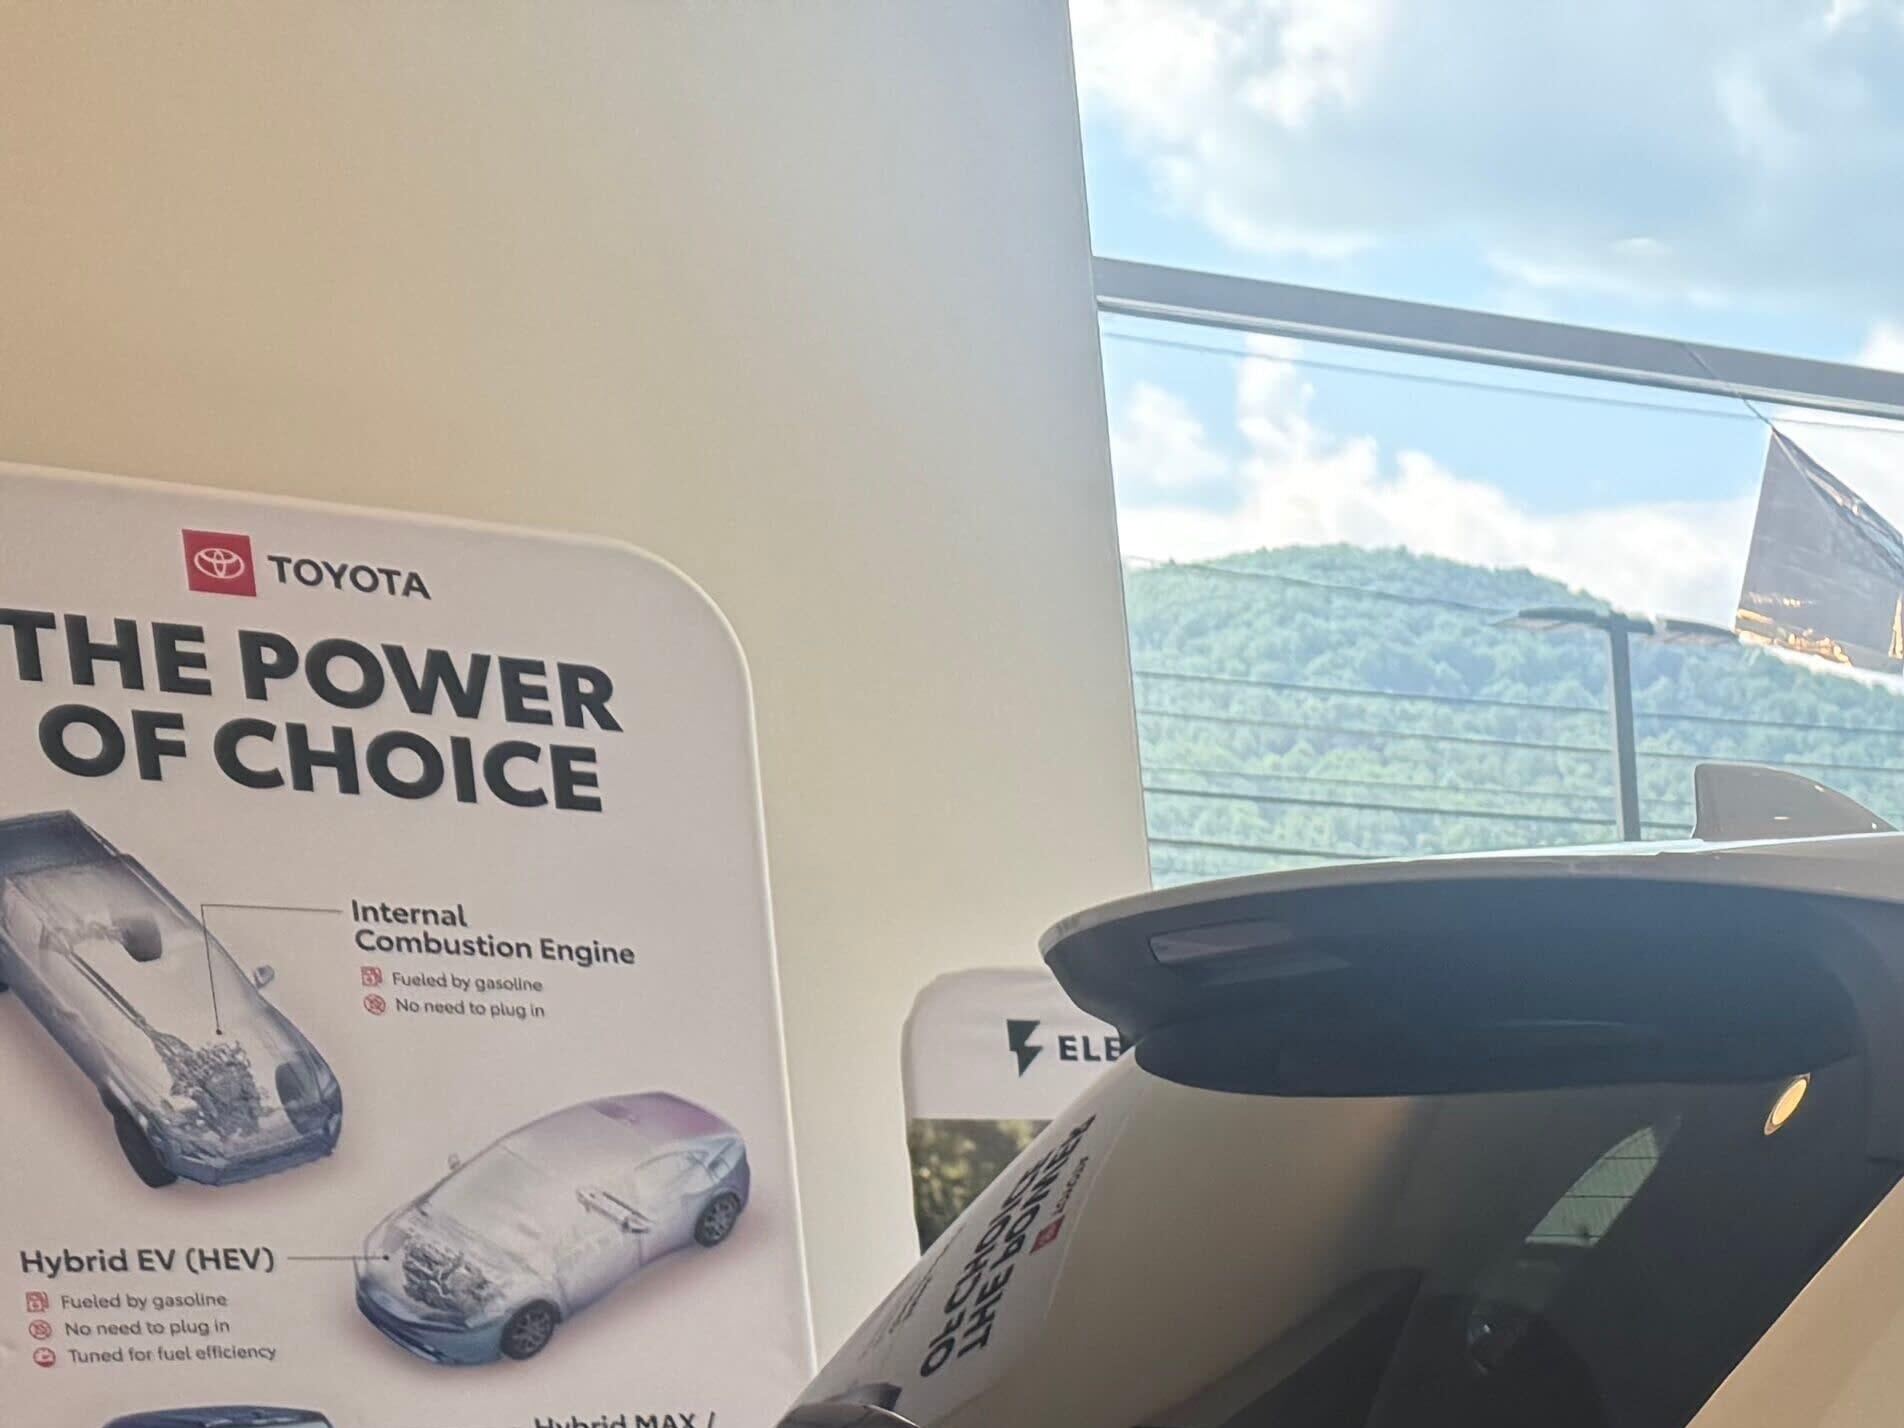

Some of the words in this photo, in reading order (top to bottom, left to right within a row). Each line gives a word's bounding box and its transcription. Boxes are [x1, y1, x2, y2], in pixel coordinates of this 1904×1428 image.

[267, 554, 431, 600] TOYOTA
[0, 607, 213, 696] THE
[237, 629, 623, 732] POWER
[39, 704, 187, 781] OF
[214, 718, 603, 812] CHOICE
[352, 899, 468, 928] Internal
[355, 929, 532, 959] Combustion
[540, 938, 636, 967] Engine
[392, 972, 447, 988] Fueled
[451, 974, 470, 991] by
[475, 976, 543, 993] gasoline
[396, 998, 419, 1013] No
[424, 1000, 465, 1015] need
[469, 1002, 486, 1016] to
[491, 1002, 526, 1020] plug
[531, 1004, 545, 1018] in
[20, 1248, 128, 1279] Hybrid
[138, 1248, 176, 1271] EV
[186, 1246, 274, 1274] (HEV)
[61, 1294, 121, 1310] Fueled
[126, 1293, 147, 1311] by
[153, 1293, 228, 1312] gasoline
[65, 1321, 92, 1336] No
[97, 1320, 141, 1336] need
[146, 1321, 164, 1335] to
[170, 1319, 210, 1338] plug
[214, 1317, 230, 1333] in
[68, 1347, 123, 1364] Tuned
[128, 1346, 152, 1362] for
[158, 1345, 191, 1361] fuel
[196, 1345, 277, 1363] efficiency
